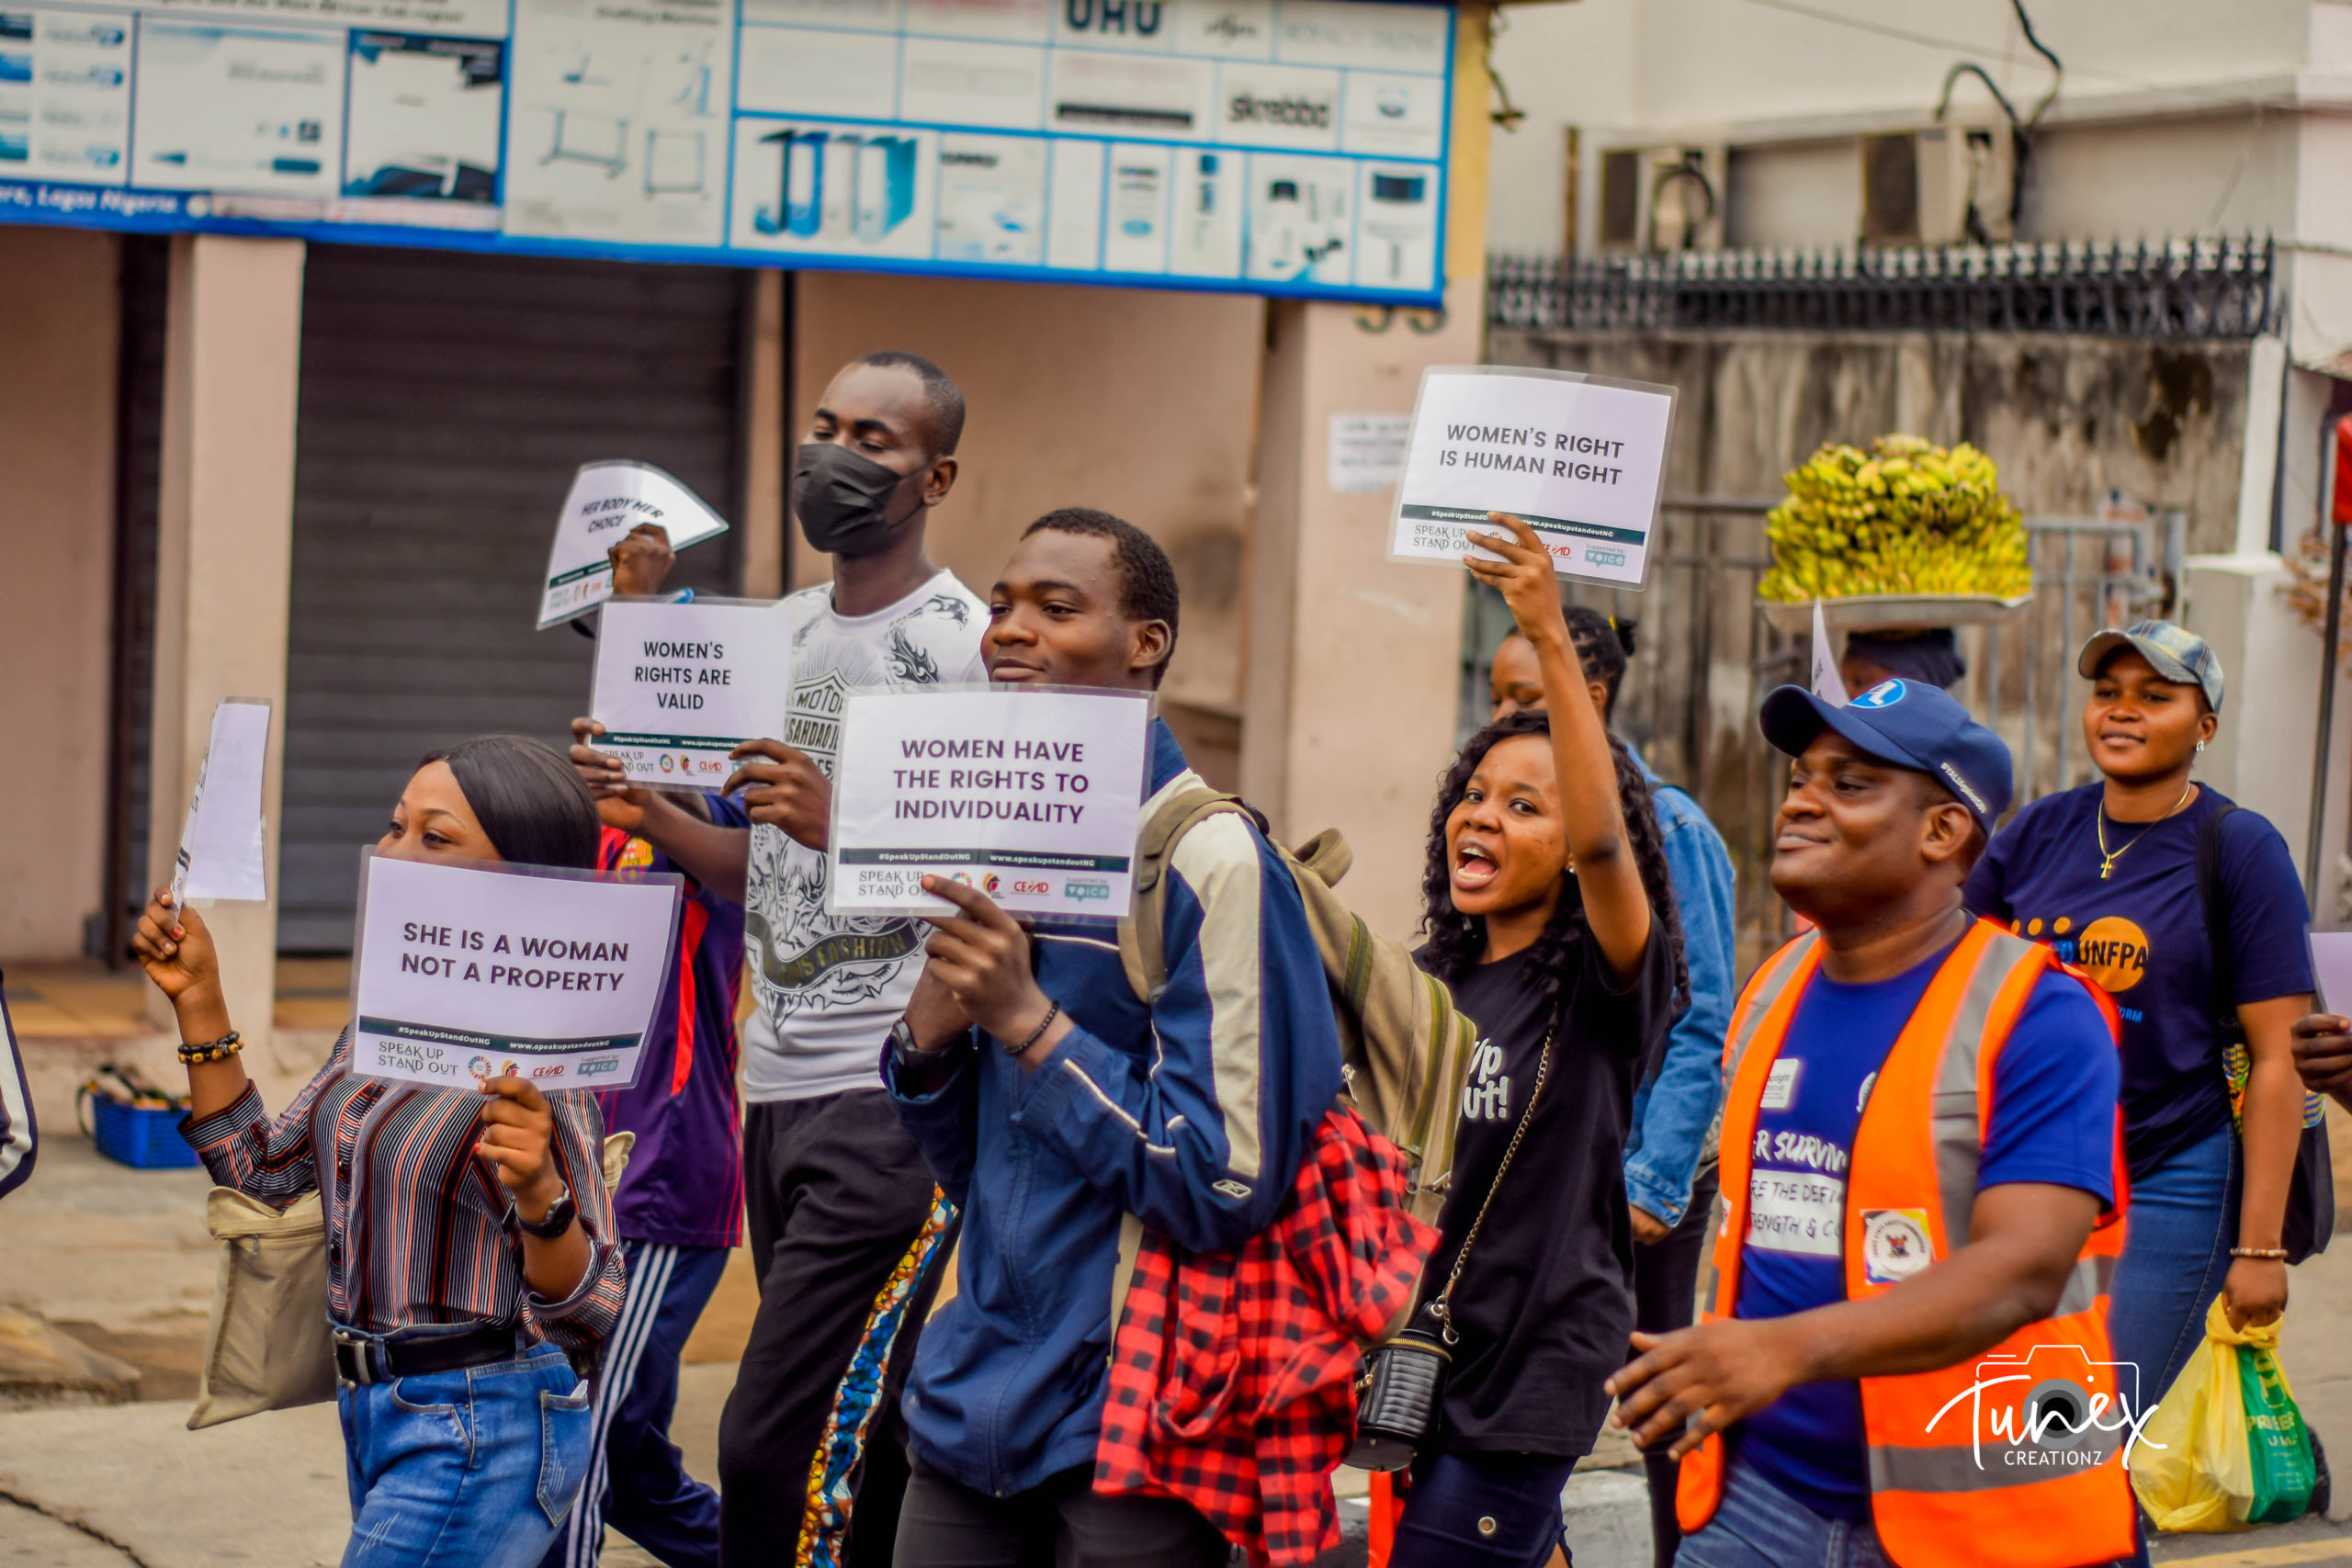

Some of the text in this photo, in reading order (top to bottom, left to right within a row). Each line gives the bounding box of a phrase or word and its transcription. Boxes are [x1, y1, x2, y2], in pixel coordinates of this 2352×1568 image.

[1065, 0, 1163, 36] UHU
[1446, 424, 1624, 458] WOMEN'S RIGHT
[1440, 450, 1623, 485] IS HUMAN RIGHT
[601, 498, 634, 512] BODY
[632, 501, 664, 518] HER
[1431, 511, 1488, 521] #SpeakUpStandO
[588, 514, 626, 533] CHOICE
[1415, 525, 1466, 539] SPEAK UP
[1413, 537, 1450, 551] STAND
[644, 641, 723, 660] WOMEN'S
[635, 666, 731, 685] RIGHTS ARE
[657, 693, 704, 709] VALID
[797, 684, 843, 714] MOTO
[634, 751, 645, 761] UP
[901, 739, 1084, 762] WOMEN HAVE
[637, 762, 654, 773] OUT
[893, 770, 1089, 794] THE RIGHTS TO
[895, 800, 1084, 824] INDIVIDUALITY
[859, 871, 903, 885] SPEAK
[858, 885, 903, 898] STAND
[403, 921, 629, 962] SHE IS A WOMAN
[816, 931, 907, 967] FASHION
[2079, 941, 2148, 970] UNFPA
[401, 953, 625, 991] NOT A PROPERTY
[2117, 1005, 2143, 1023] ORM
[379, 1041, 444, 1060] SPEAK UP
[378, 1055, 458, 1076] STAND OUT
[1464, 1076, 1509, 1119] ut!
[1753, 1129, 1771, 1161] R
[1772, 1182, 1798, 1201] THE
[1803, 1185, 1840, 1203] DEFI
